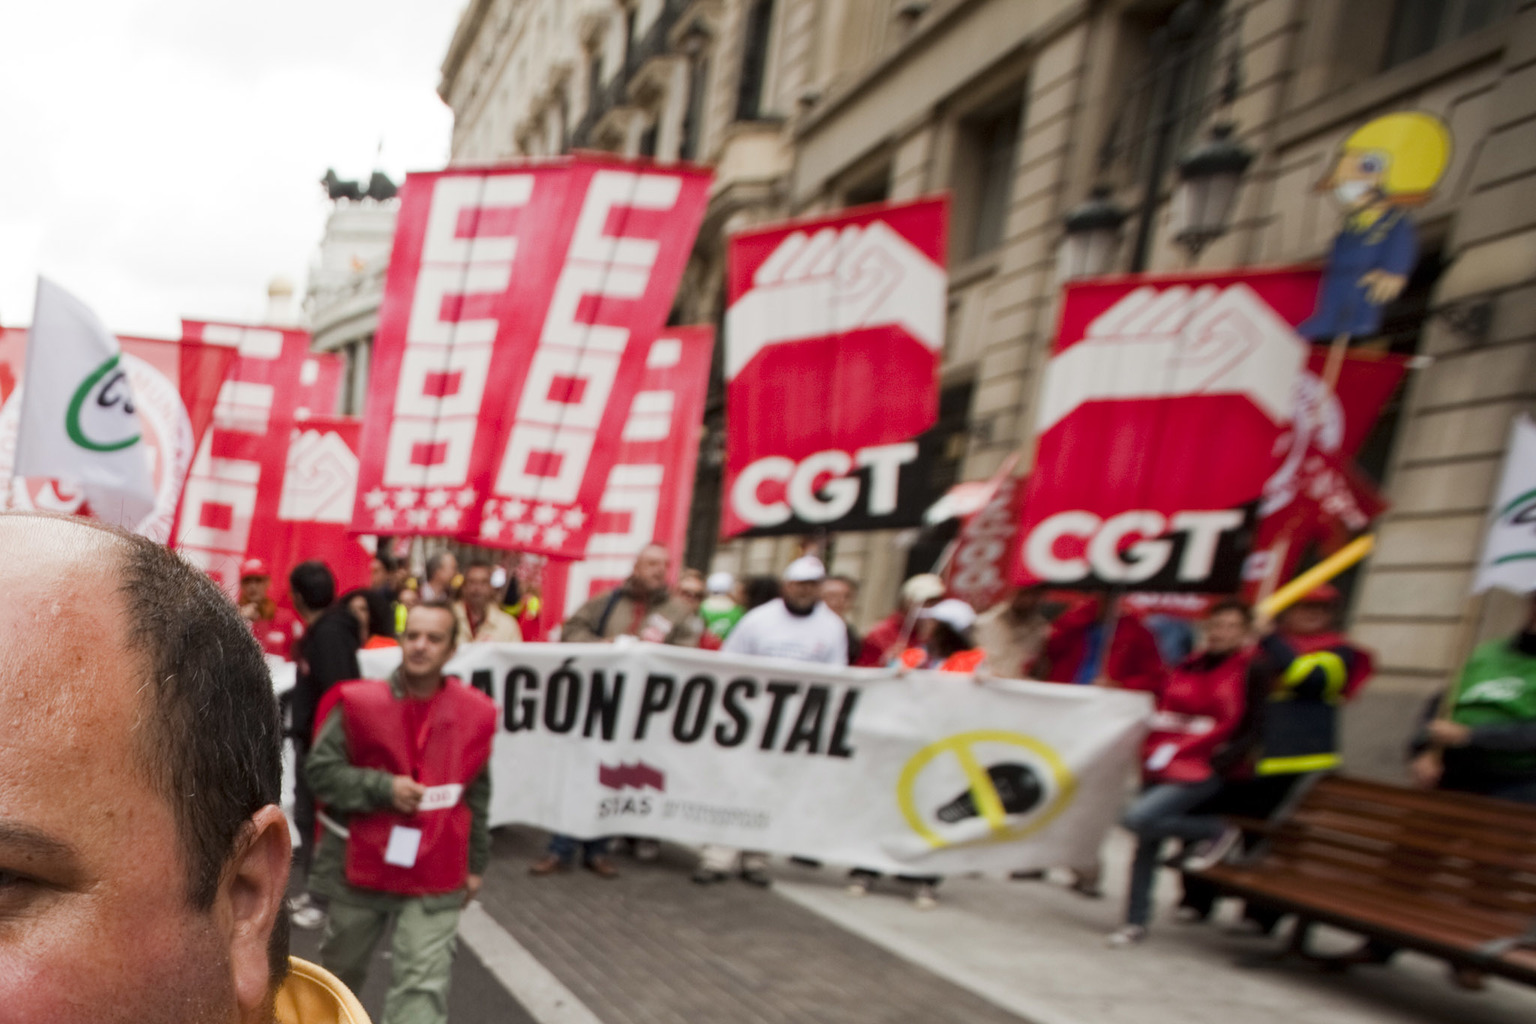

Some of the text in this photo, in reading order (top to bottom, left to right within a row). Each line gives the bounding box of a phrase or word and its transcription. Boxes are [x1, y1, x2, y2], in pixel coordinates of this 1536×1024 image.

[732, 441, 919, 527] CGT
[1022, 509, 1245, 584] CGT
[632, 672, 862, 758] POSTAL
